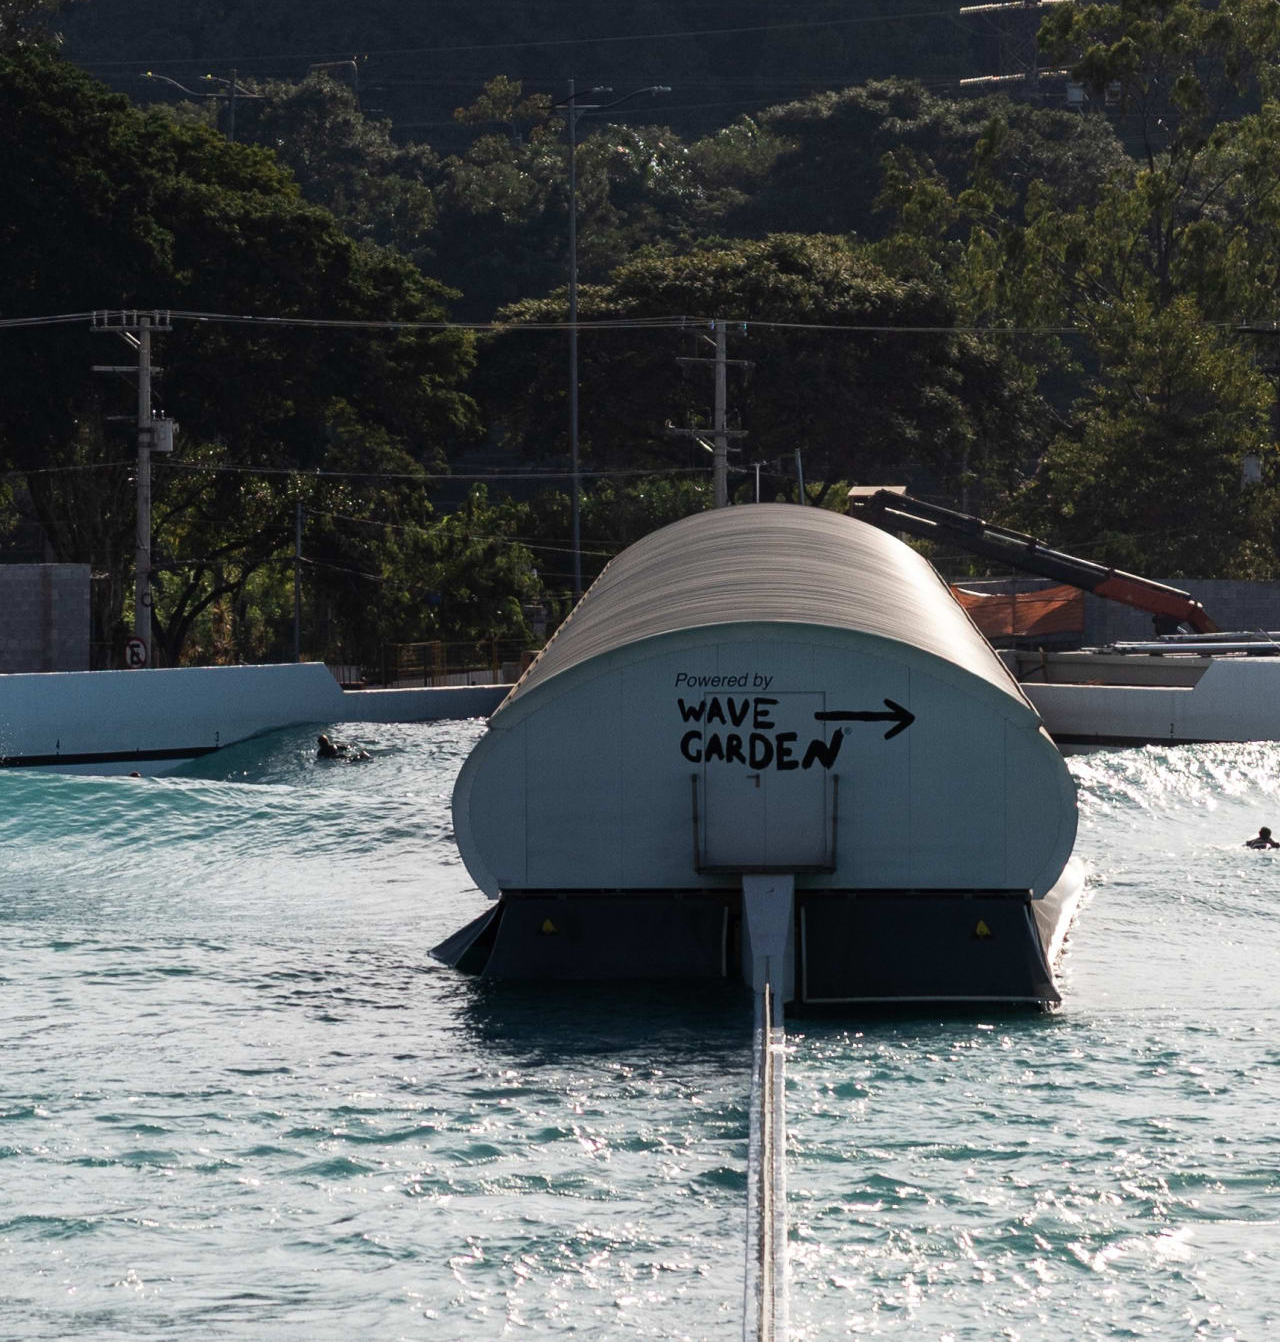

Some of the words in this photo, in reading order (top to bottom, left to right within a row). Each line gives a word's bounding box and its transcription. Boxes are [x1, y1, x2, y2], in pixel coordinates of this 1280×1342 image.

[674, 672, 749, 688] Powered
[752, 672, 774, 691] by
[677, 697, 780, 730] WAVE
[680, 726, 845, 771] GARDEN
